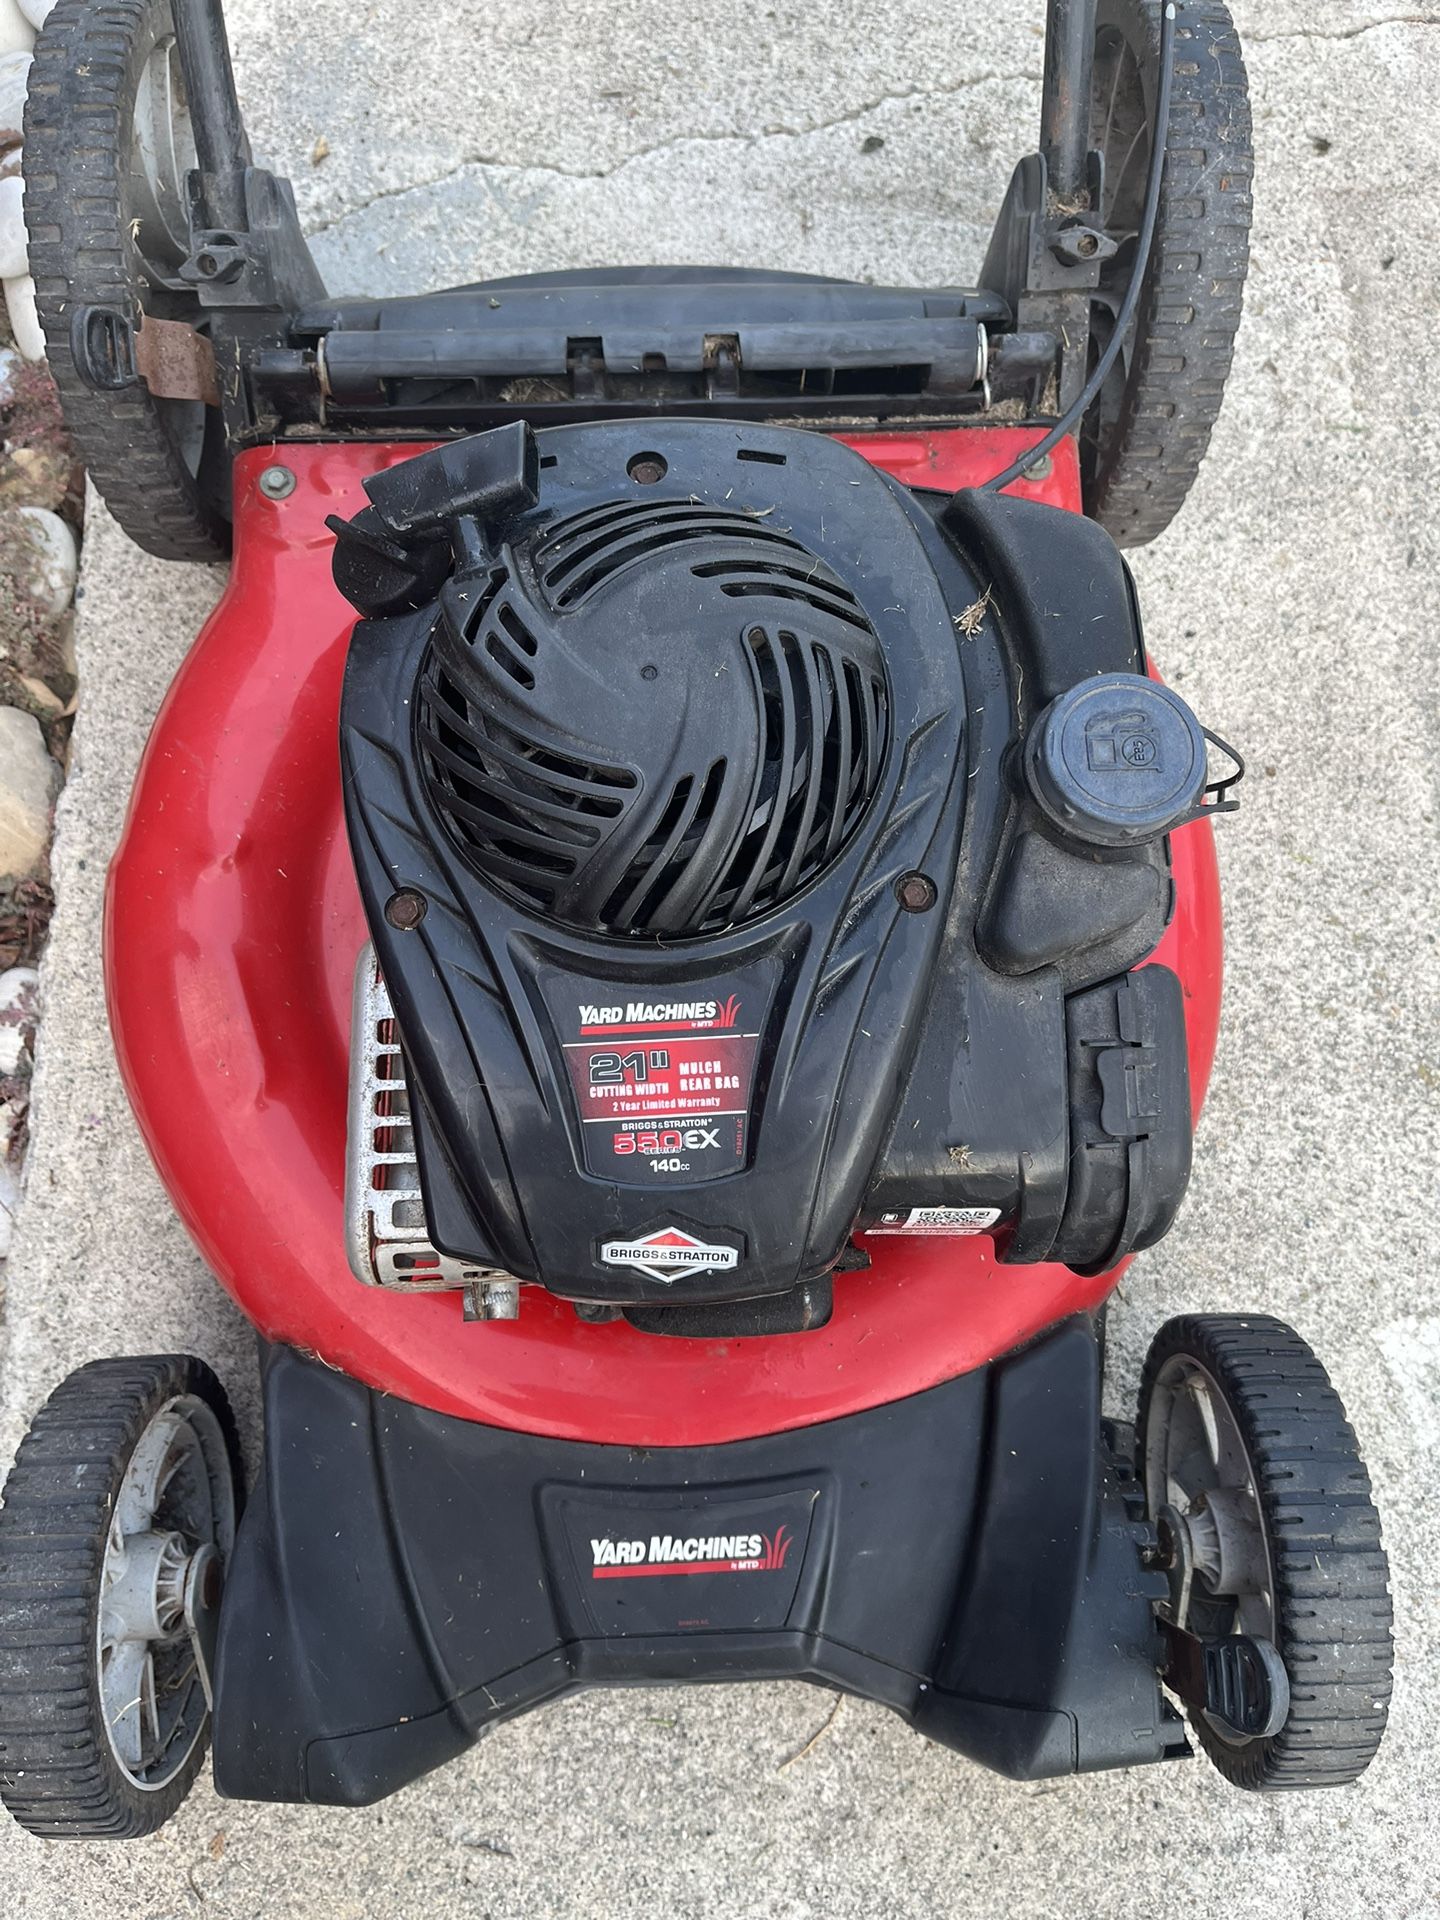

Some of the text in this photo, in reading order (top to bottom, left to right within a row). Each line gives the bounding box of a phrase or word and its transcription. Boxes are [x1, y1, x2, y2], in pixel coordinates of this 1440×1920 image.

[578, 1000, 717, 1025] YARD MACHINES
[697, 1020, 714, 1028] MTD
[589, 1049, 669, 1084] 21"
[679, 1060, 722, 1076] MULCH
[589, 1082, 669, 1098] CUTTING WIDTH
[679, 1075, 740, 1092] REAR BAG
[612, 1096, 720, 1111] 2 Year Limited Warranty
[590, 1534, 762, 1566] YARD MACHINES
[738, 1559, 760, 1569] MTD
